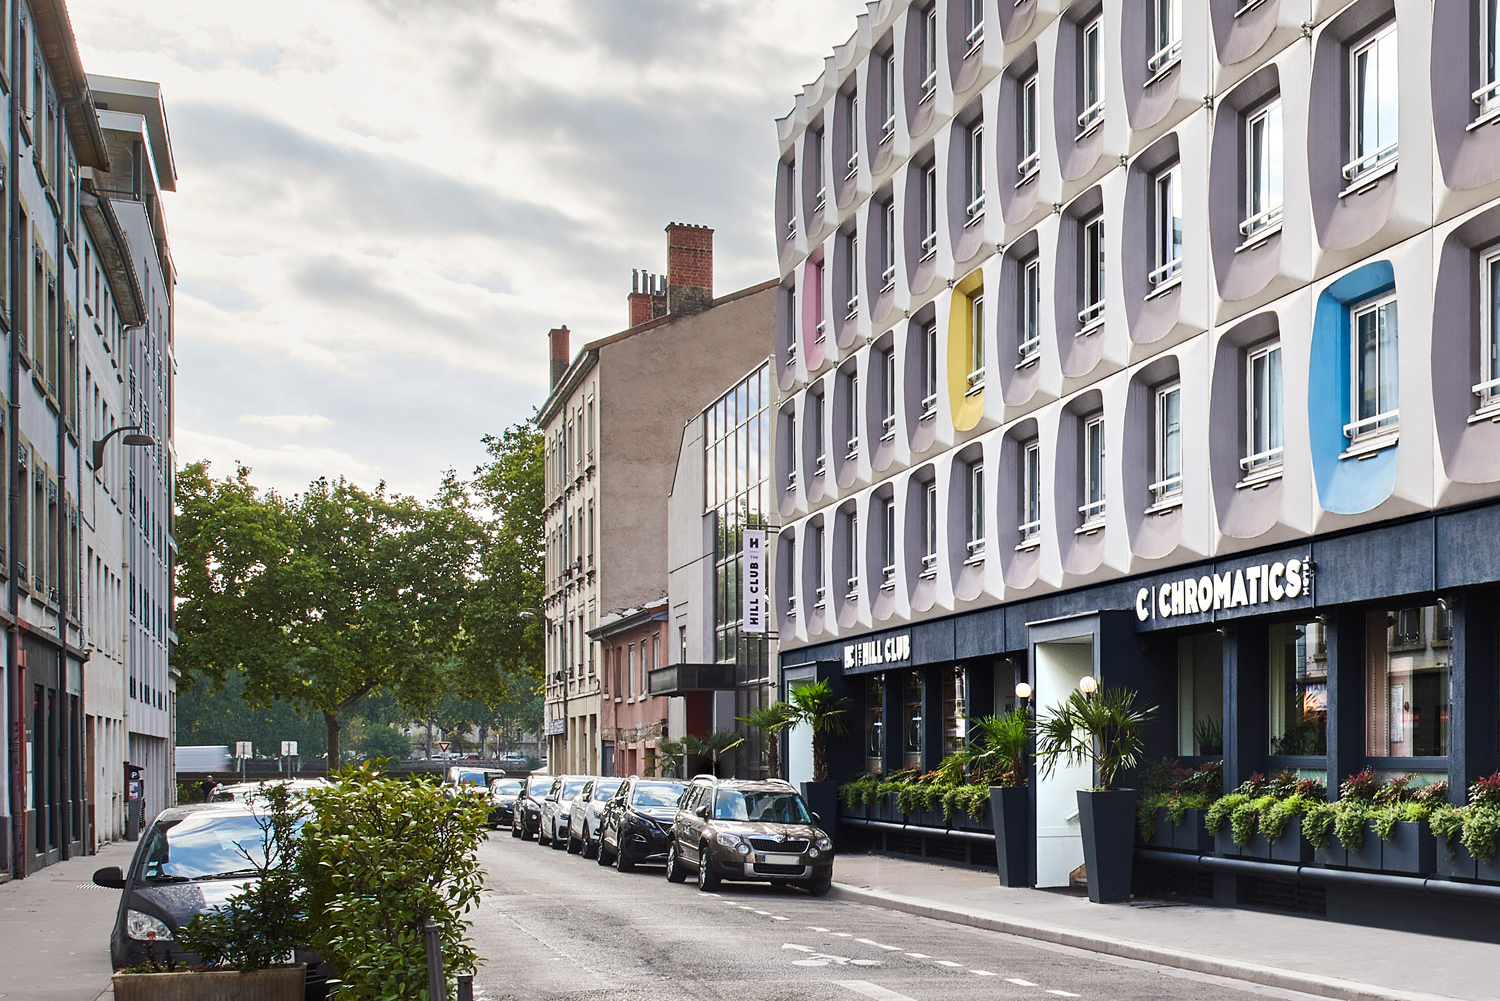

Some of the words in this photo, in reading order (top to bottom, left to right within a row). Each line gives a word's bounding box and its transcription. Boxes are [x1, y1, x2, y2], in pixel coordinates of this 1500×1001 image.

[750, 562, 759, 594] CLUB
[1136, 587, 1149, 622] C
[1158, 558, 1302, 618] CHROMATICS
[1302, 555, 1310, 596] HOTEL
[750, 598, 759, 625] HILL
[862, 640, 883, 666] HILL
[884, 634, 911, 662] CLUB
